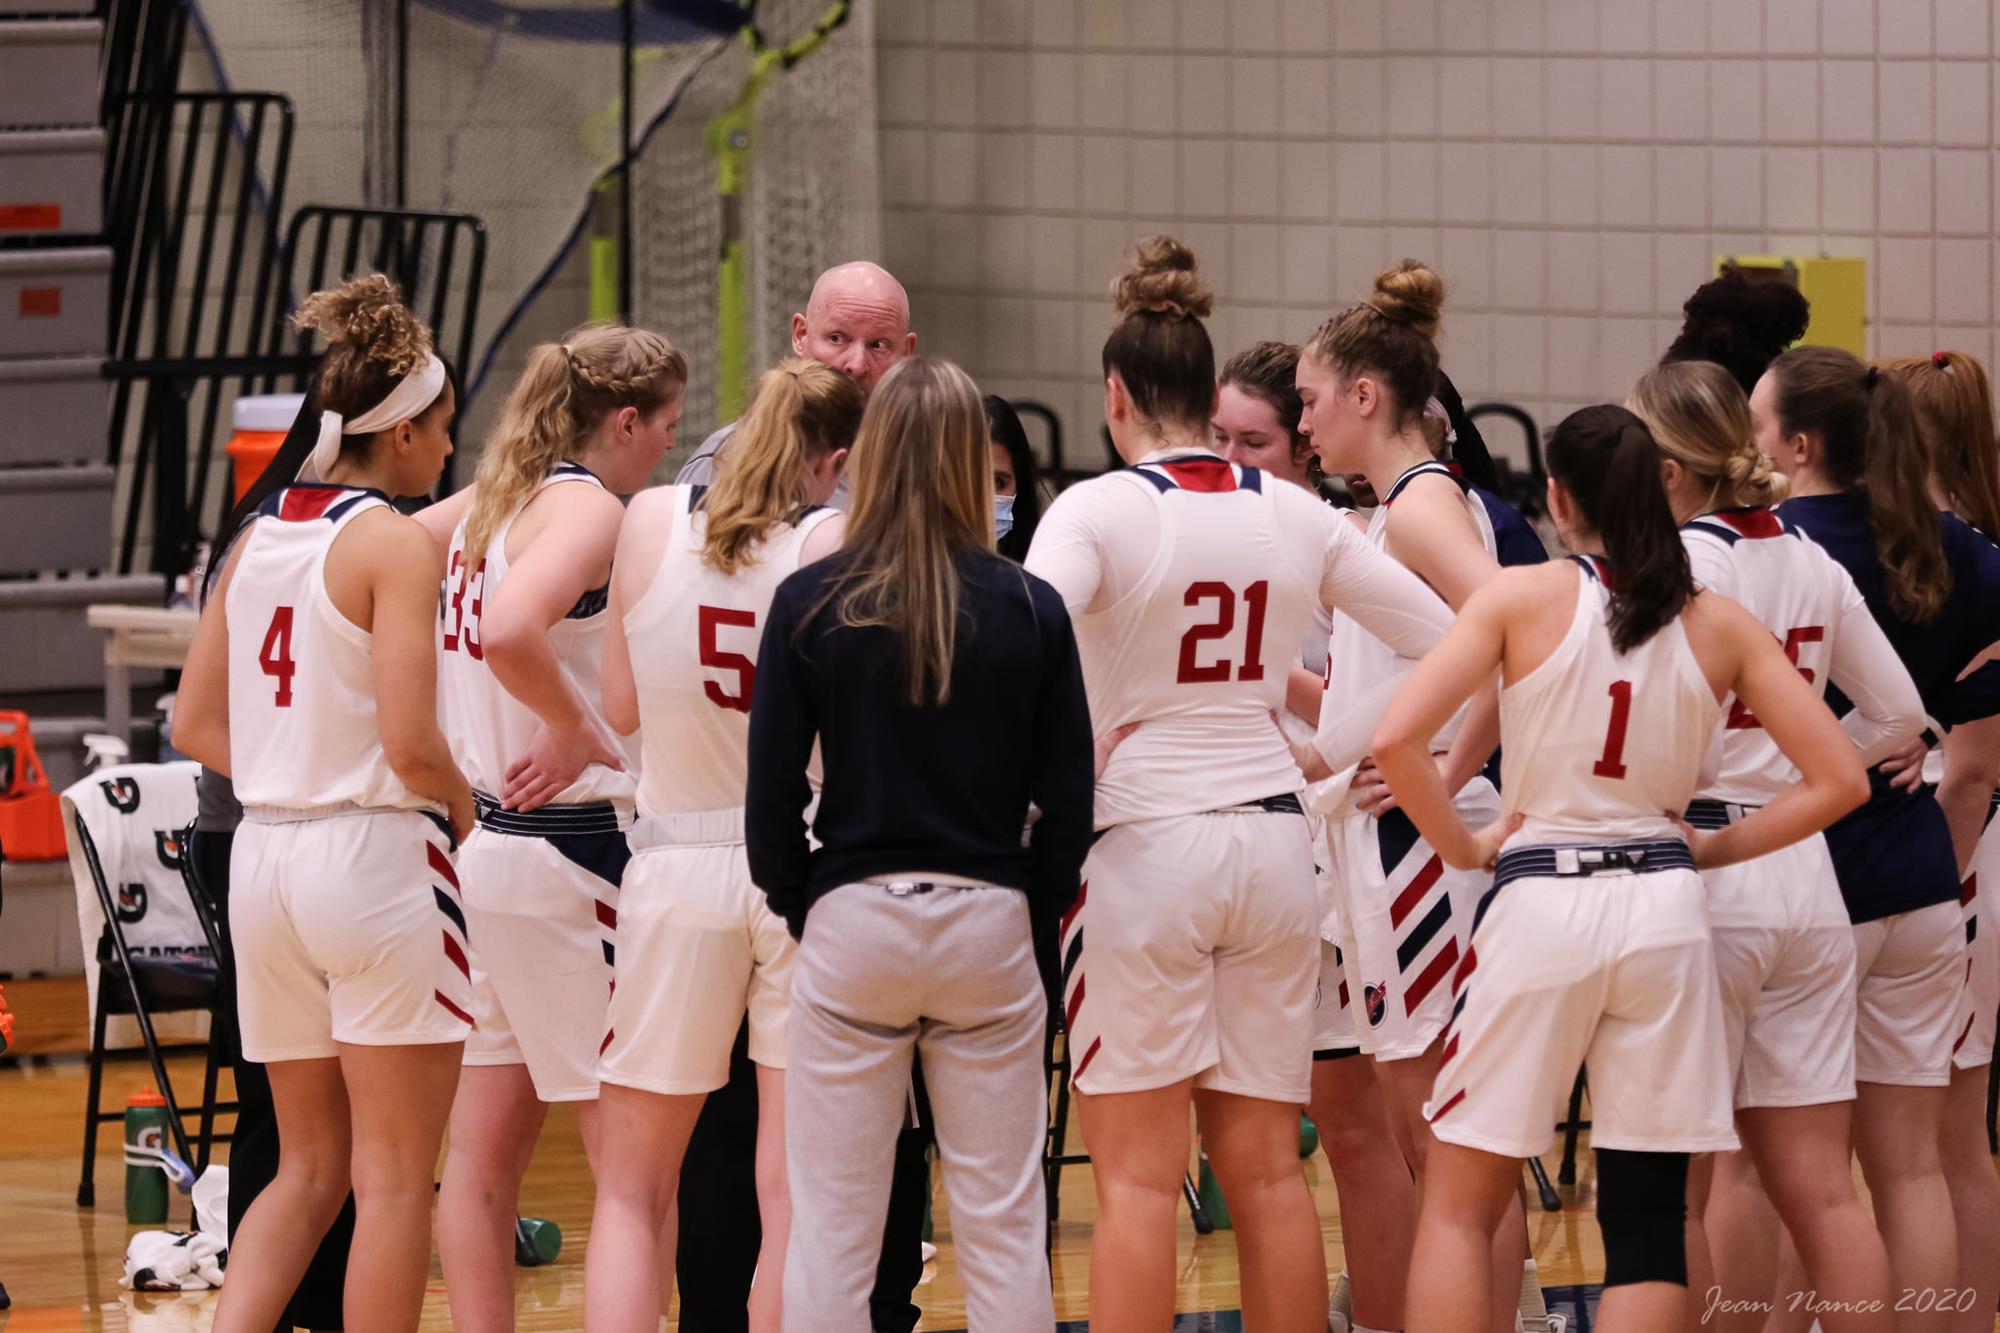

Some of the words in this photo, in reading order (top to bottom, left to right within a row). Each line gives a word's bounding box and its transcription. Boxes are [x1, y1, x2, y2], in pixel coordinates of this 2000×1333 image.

[259, 606, 296, 707] 4
[698, 605, 756, 714] 5
[1176, 580, 1269, 685] 21
[1593, 679, 1632, 780] 1
